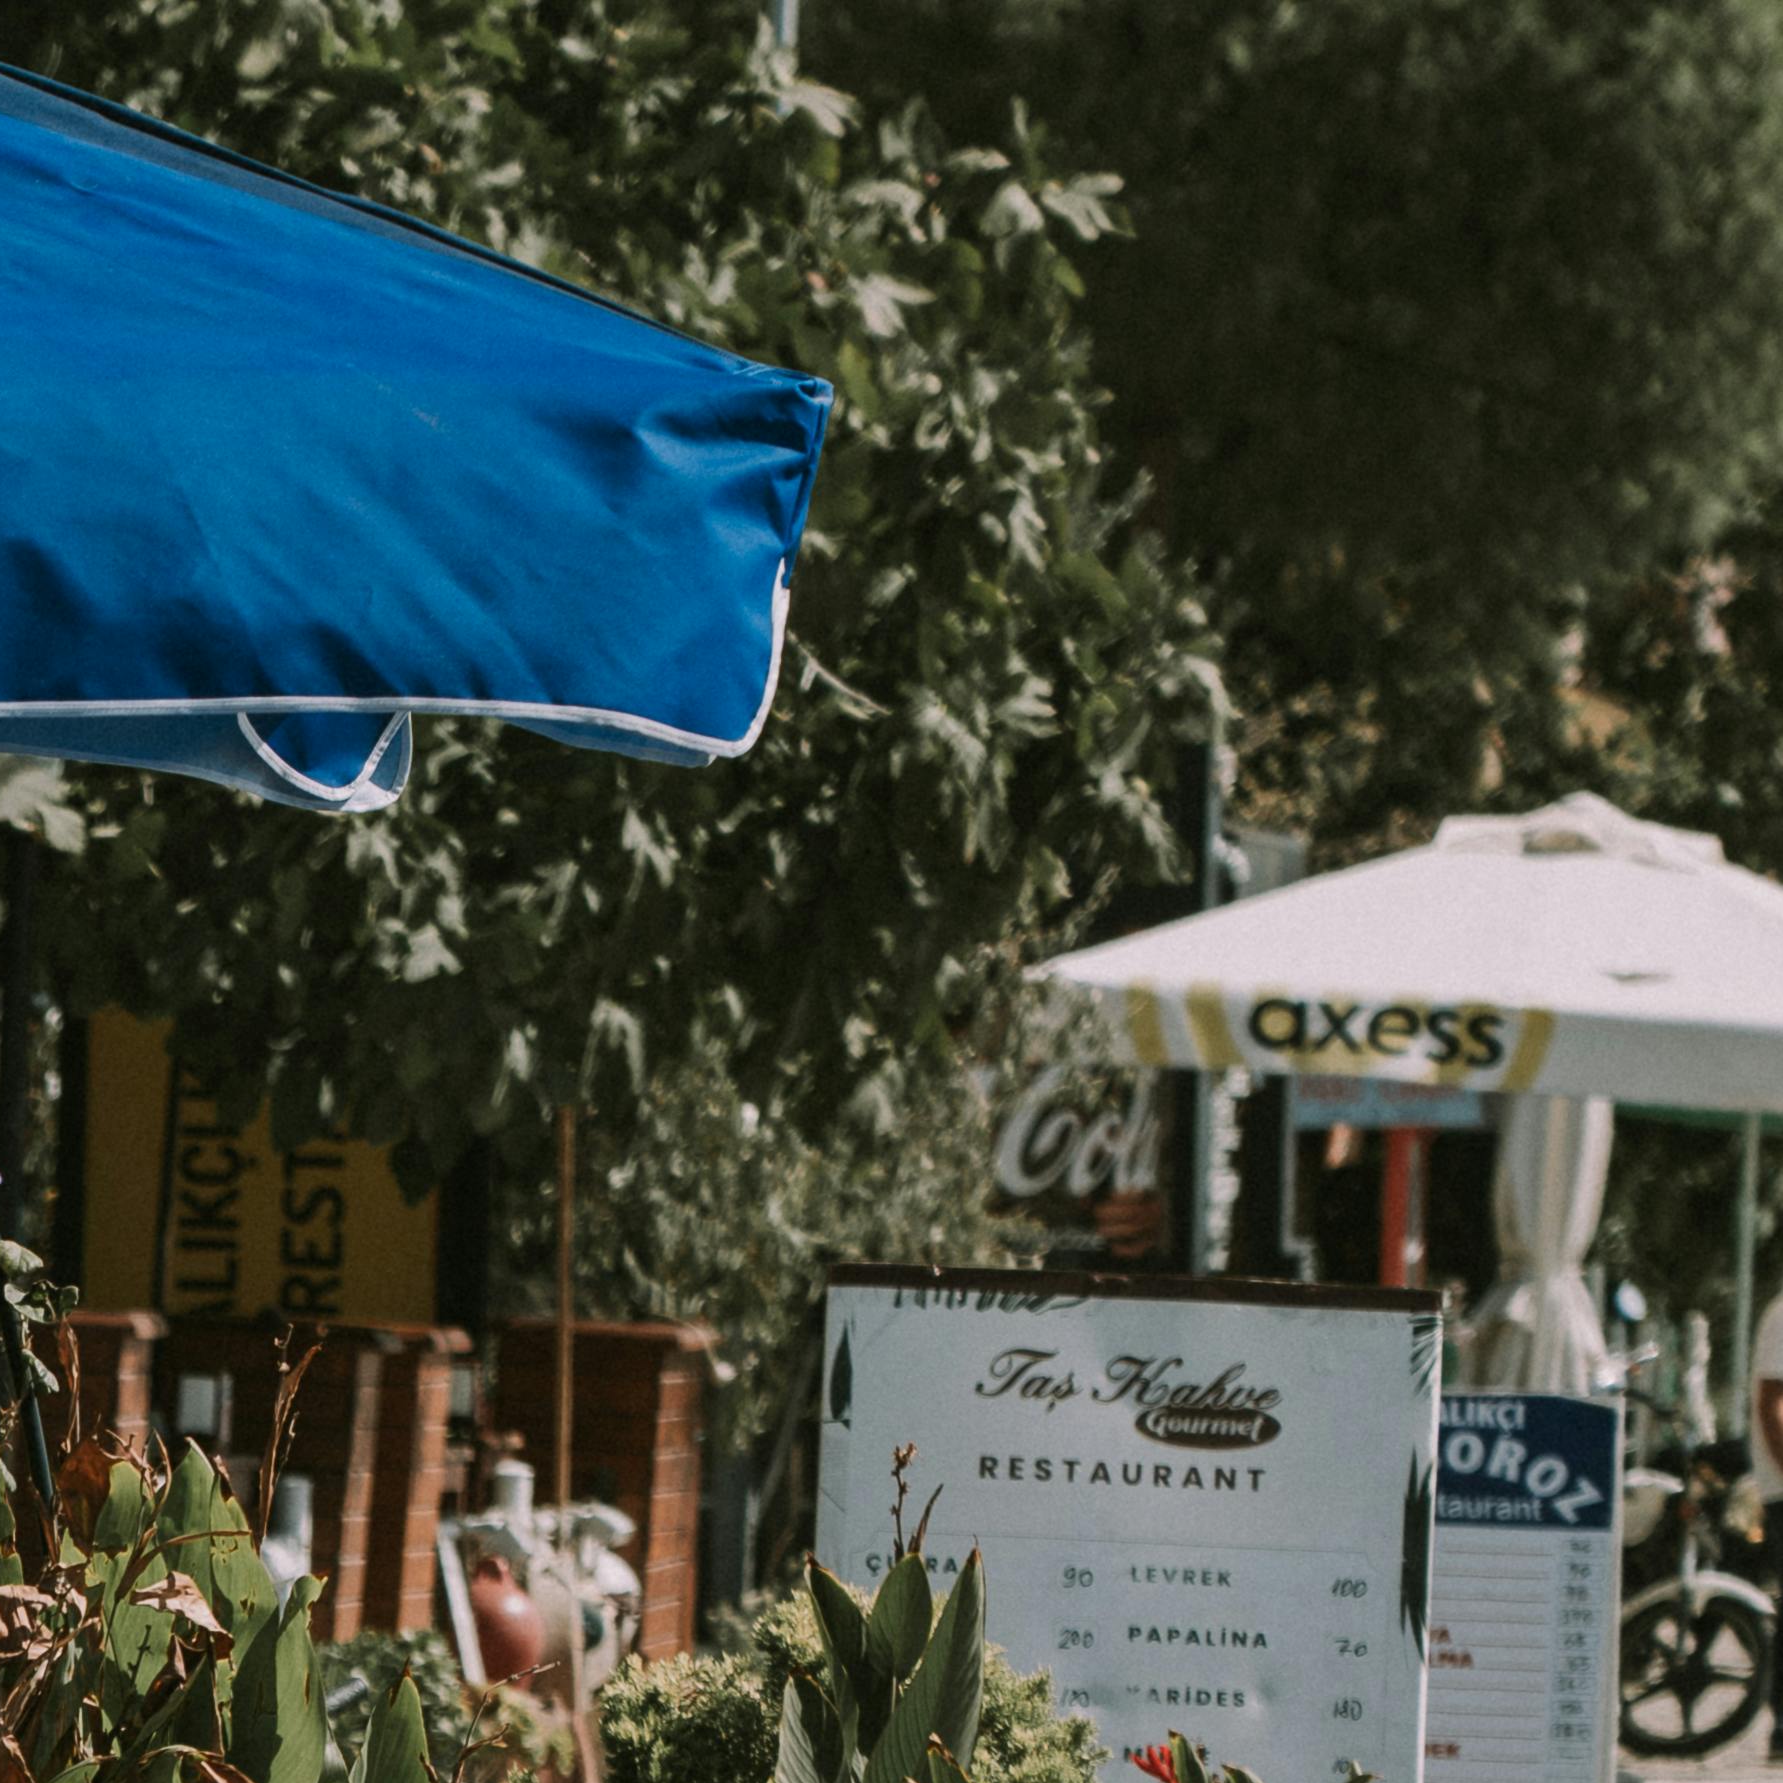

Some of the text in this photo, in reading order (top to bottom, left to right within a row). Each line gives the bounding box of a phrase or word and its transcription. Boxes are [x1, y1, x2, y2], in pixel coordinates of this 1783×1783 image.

[1248, 999, 1505, 1070] axess
[973, 1348, 1282, 1414] Taş Kahve
[978, 1456, 1266, 1491] RESTAURANT
[1129, 1565, 1233, 1588] LEVREK
[1126, 1625, 1269, 1649] PAPALİNA
